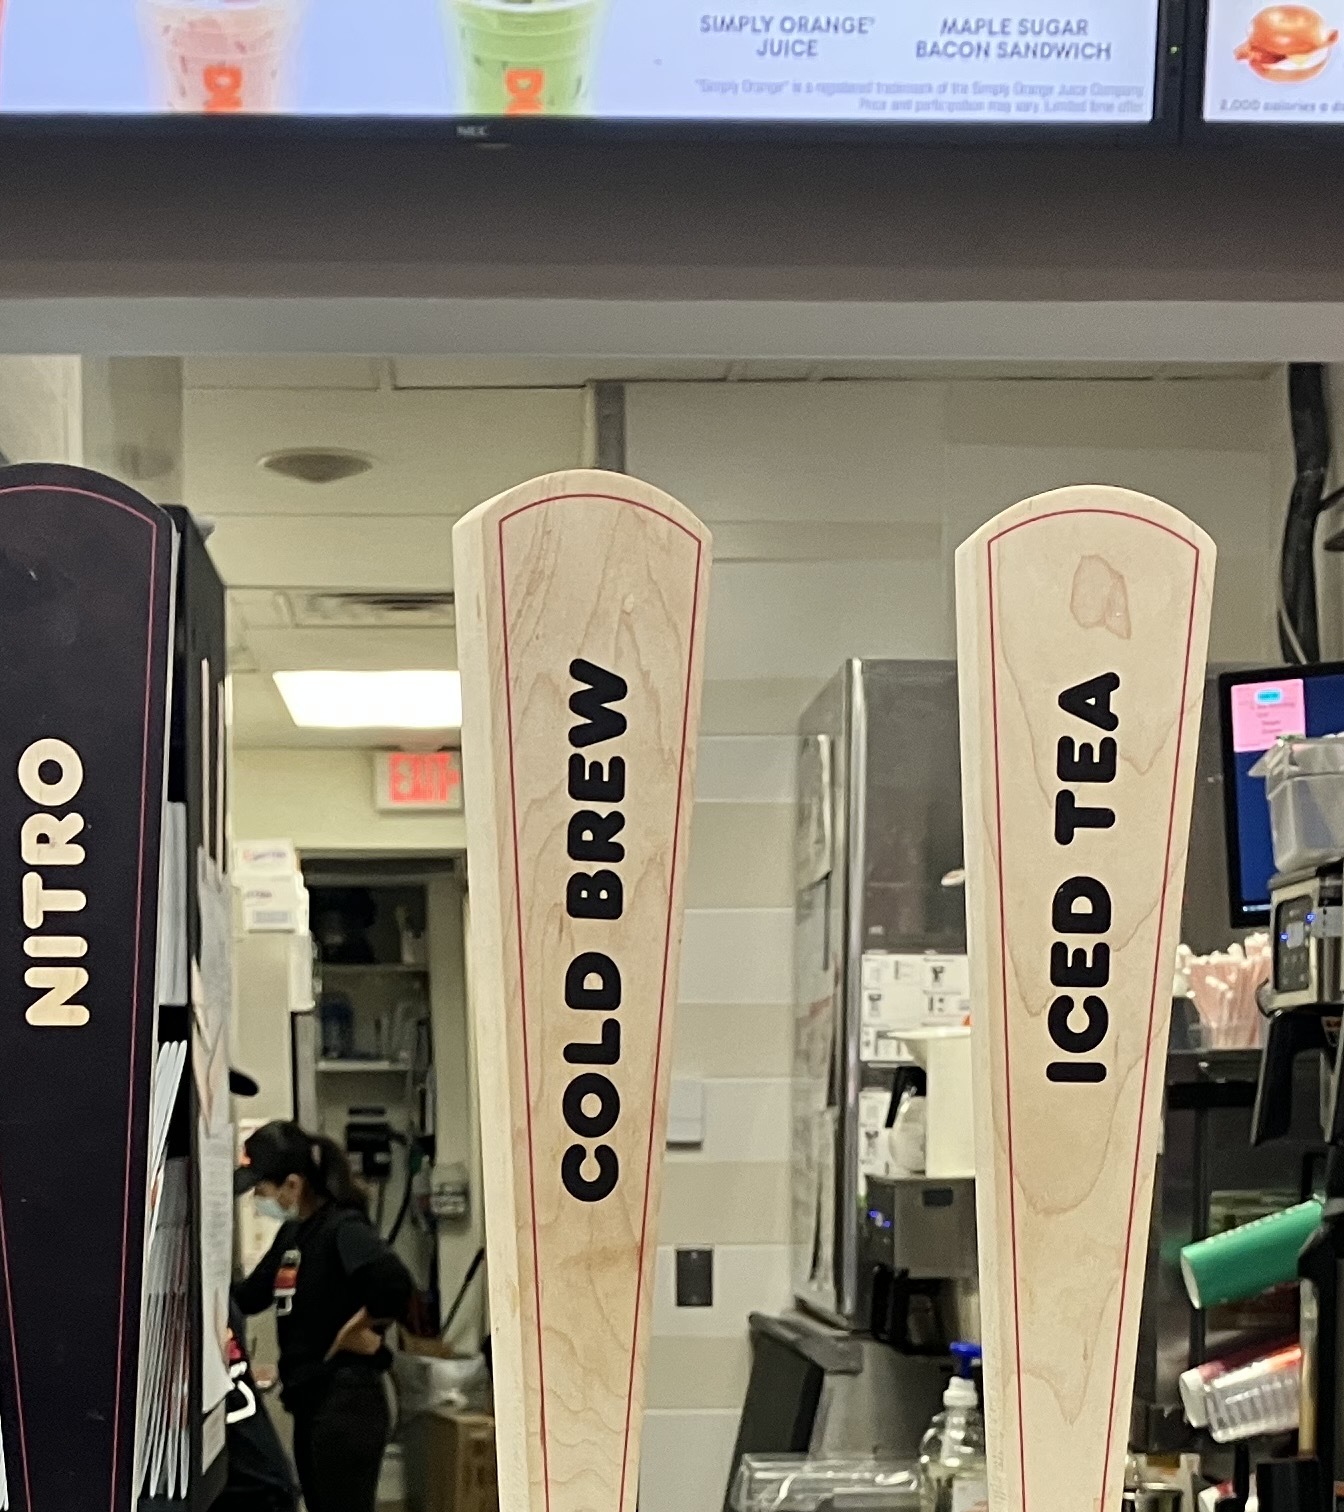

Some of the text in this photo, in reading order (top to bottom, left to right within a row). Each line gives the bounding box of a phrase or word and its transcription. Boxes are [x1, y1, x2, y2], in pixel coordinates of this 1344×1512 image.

[700, 15, 774, 34] SIMPLY
[940, 17, 1089, 37] MAPLE SUGAR
[756, 39, 818, 57] JUICE
[915, 40, 1112, 60] BACON SANDWICH
[18, 738, 90, 1026] NITRO
[1046, 671, 1121, 1083] ICED TEA
[561, 657, 629, 1203] COLD BREW
